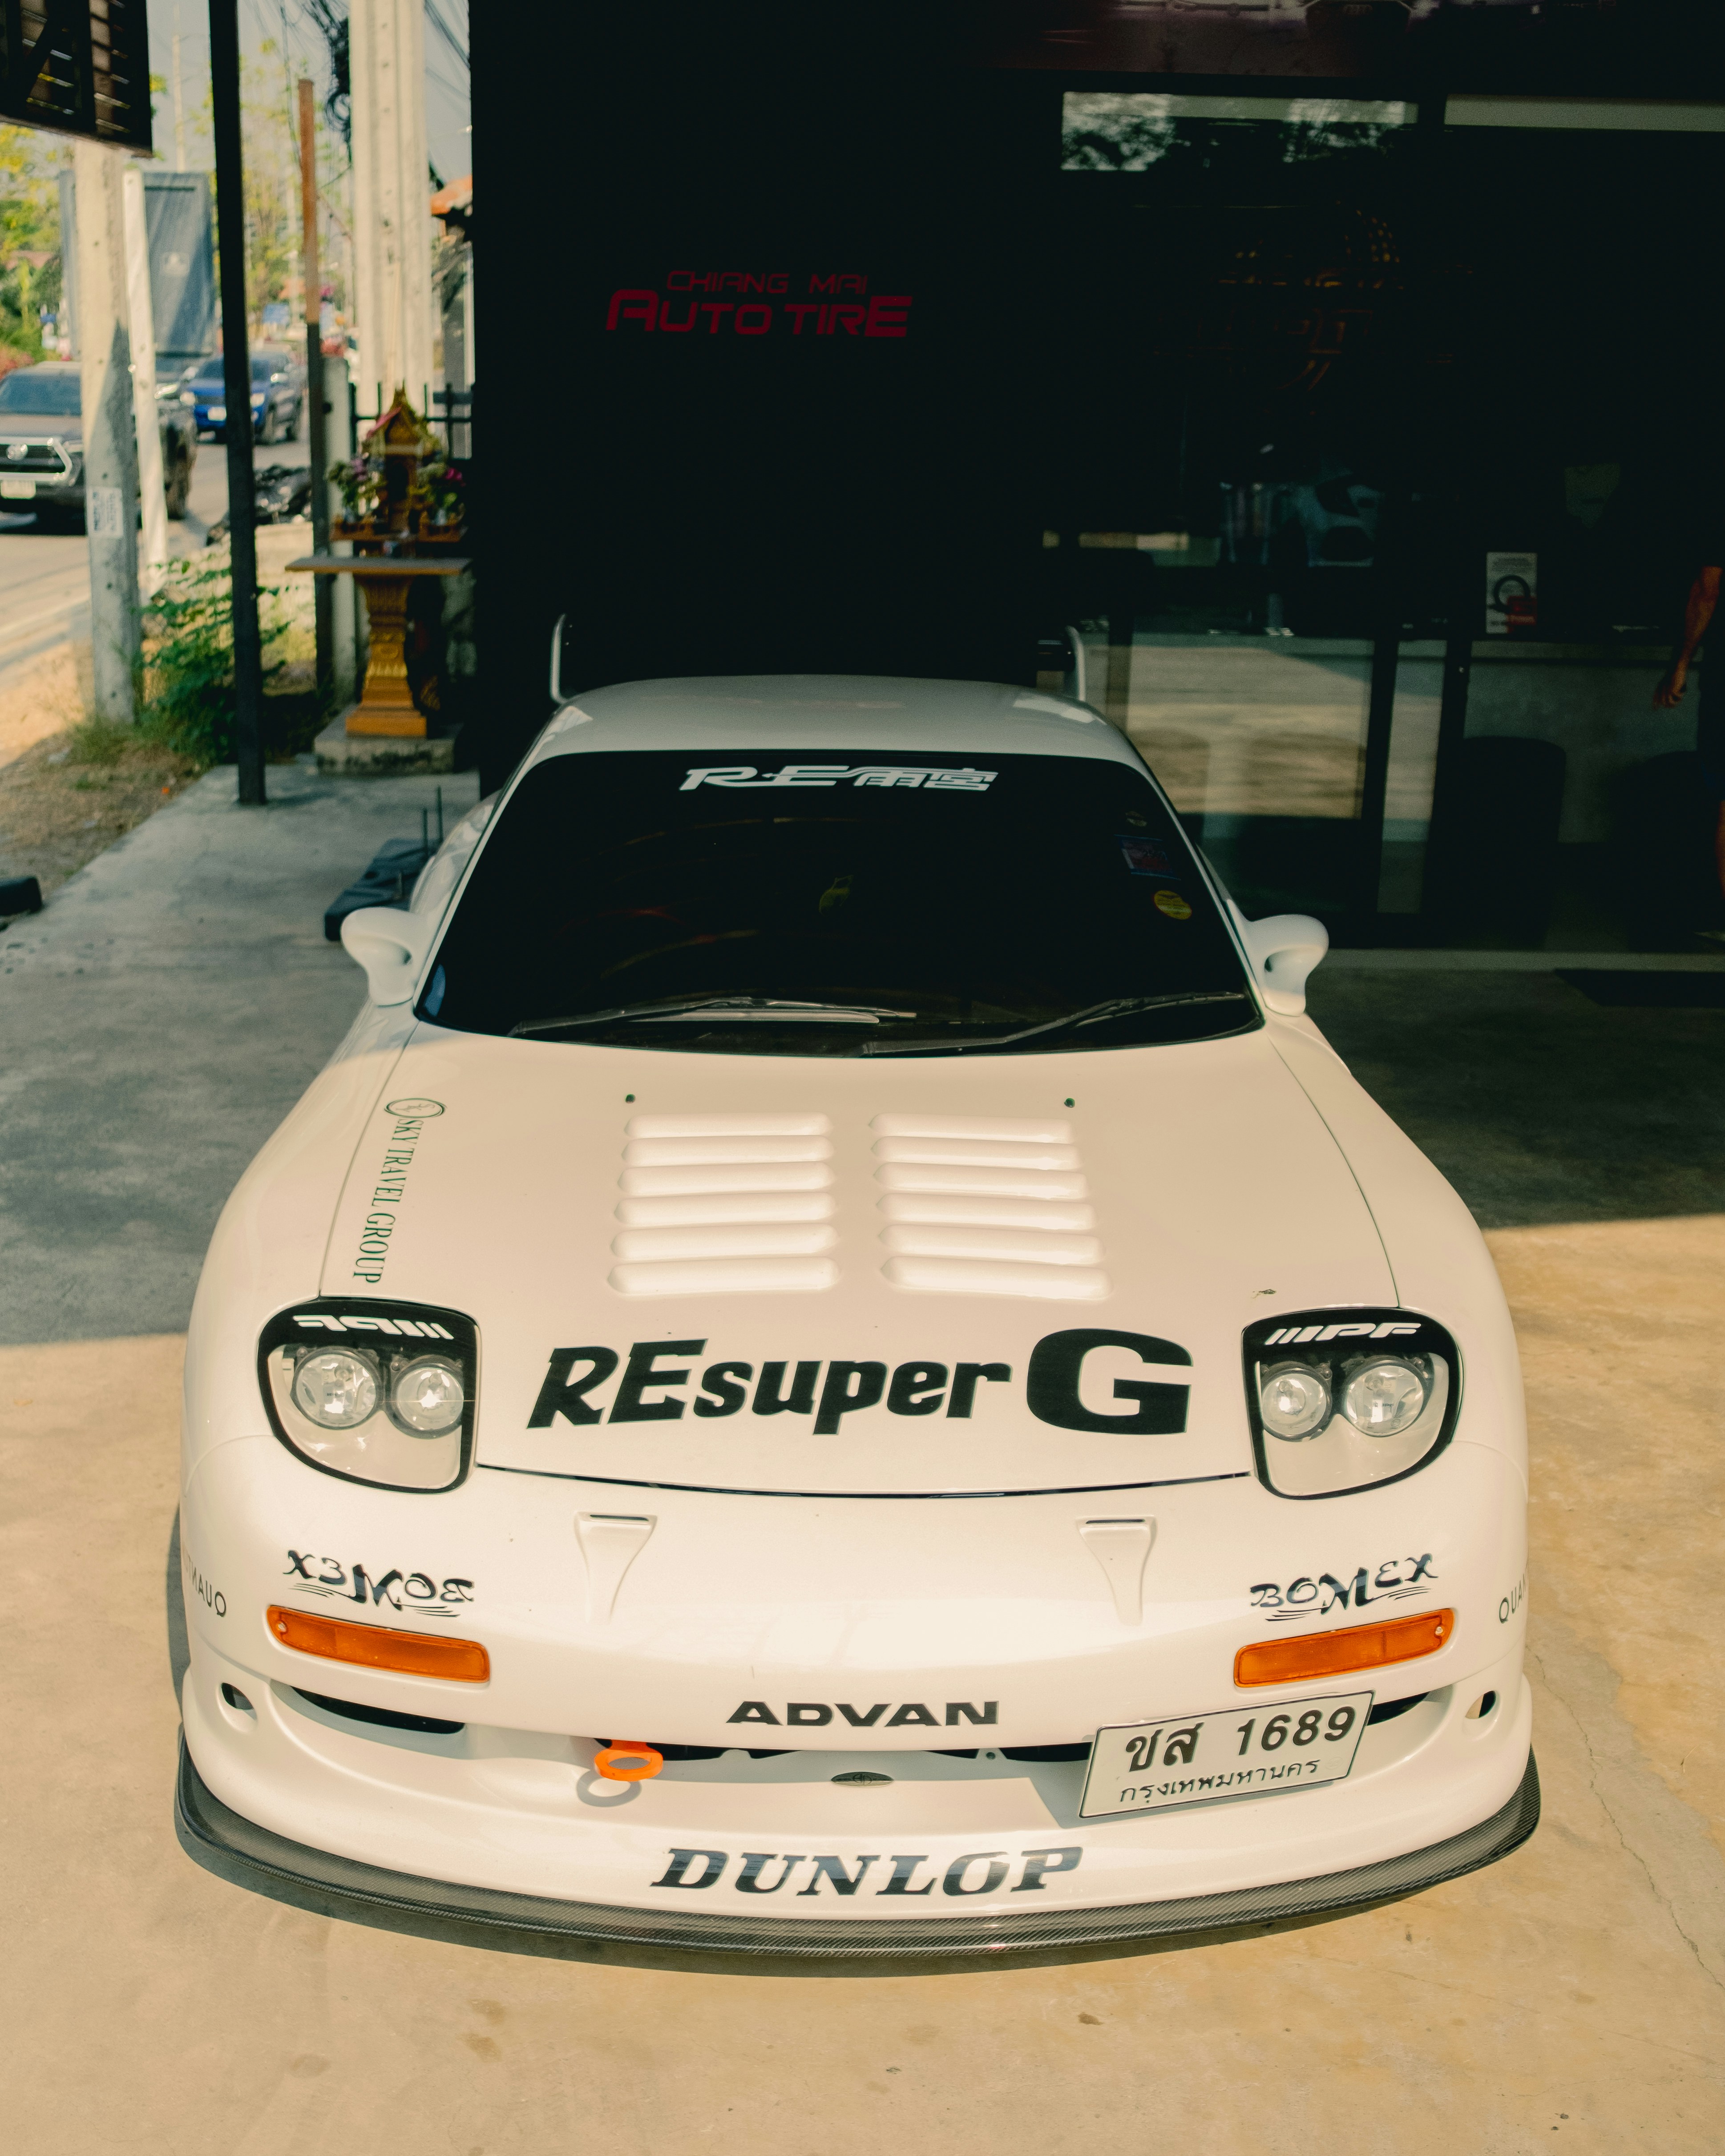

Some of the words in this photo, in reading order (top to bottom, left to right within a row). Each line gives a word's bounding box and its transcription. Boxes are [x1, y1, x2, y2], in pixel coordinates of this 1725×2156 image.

[667, 270, 790, 294] CHIANG
[808, 273, 868, 295] MAI
[606, 289, 773, 335] AUTO
[784, 295, 913, 337] TIRE
[392, 1119, 424, 1145] SKY
[371, 1147, 415, 1207] TRAVEL
[352, 1212, 396, 1284] GROUP
[1249, 1553, 1440, 1615] BOMEX
[725, 1700, 1000, 1728] ADVAN
[1125, 1721, 1205, 1772] ชส
[1236, 1705, 1356, 1756] 1689
[1119, 1759, 1321, 1803] กรุงเทพมหานคร
[650, 1846, 1084, 1897] DUNLOP
